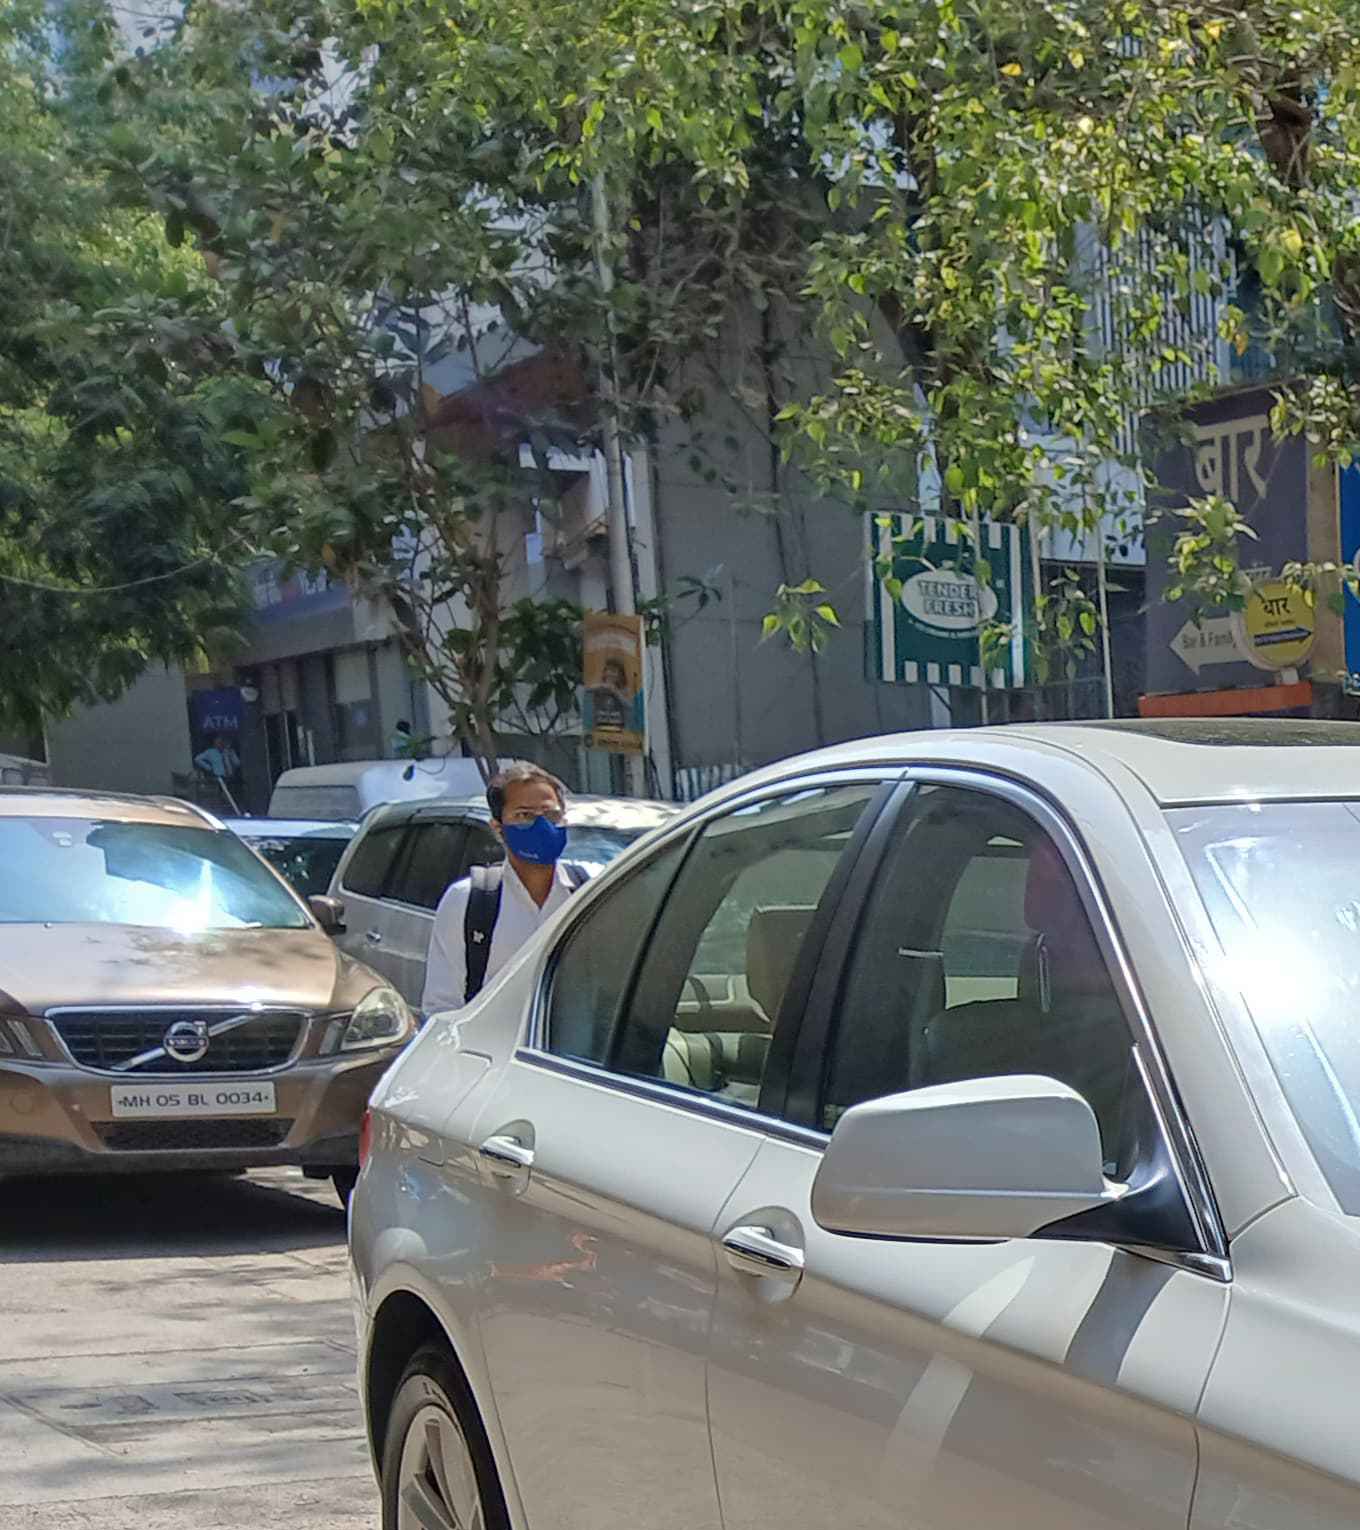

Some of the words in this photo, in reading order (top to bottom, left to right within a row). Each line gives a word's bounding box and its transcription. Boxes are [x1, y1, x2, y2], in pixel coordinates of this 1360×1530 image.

[917, 580, 978, 601] TENDER
[923, 598, 977, 619] FRESH
[204, 715, 240, 729] ATM
[122, 1095, 151, 1108] MH
[187, 1093, 209, 1106] BL
[215, 1091, 263, 1105] 0034
